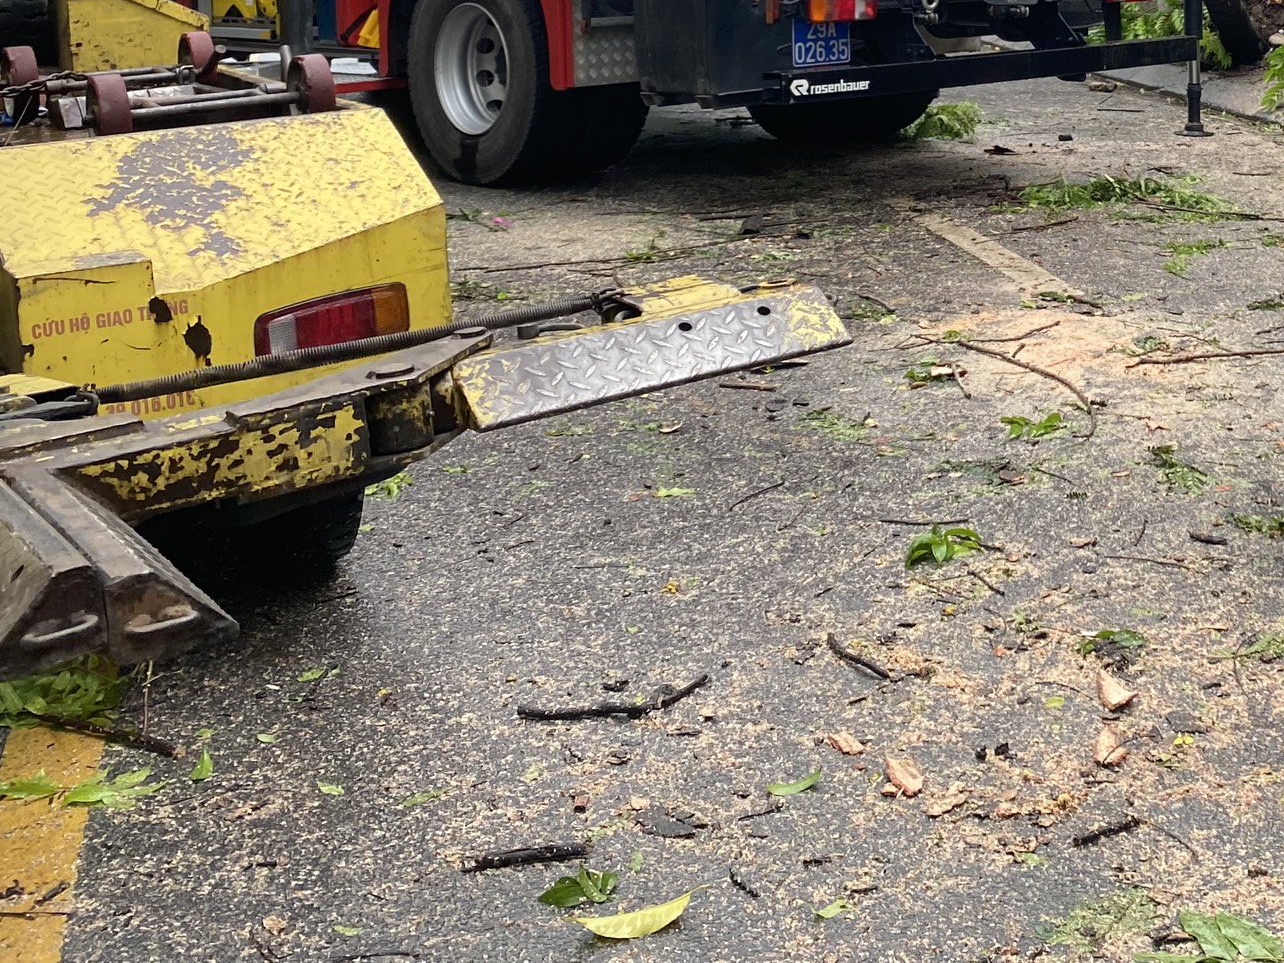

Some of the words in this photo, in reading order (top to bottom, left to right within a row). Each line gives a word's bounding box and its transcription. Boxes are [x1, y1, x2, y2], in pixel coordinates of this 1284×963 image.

[795, 39, 848, 64] 026.35
[810, 79, 870, 95] rosenbauer
[31, 317, 65, 339] CỨU
[69, 313, 91, 335] HỘ
[96, 308, 133, 329] GIAO
[137, 299, 189, 322] THNG
